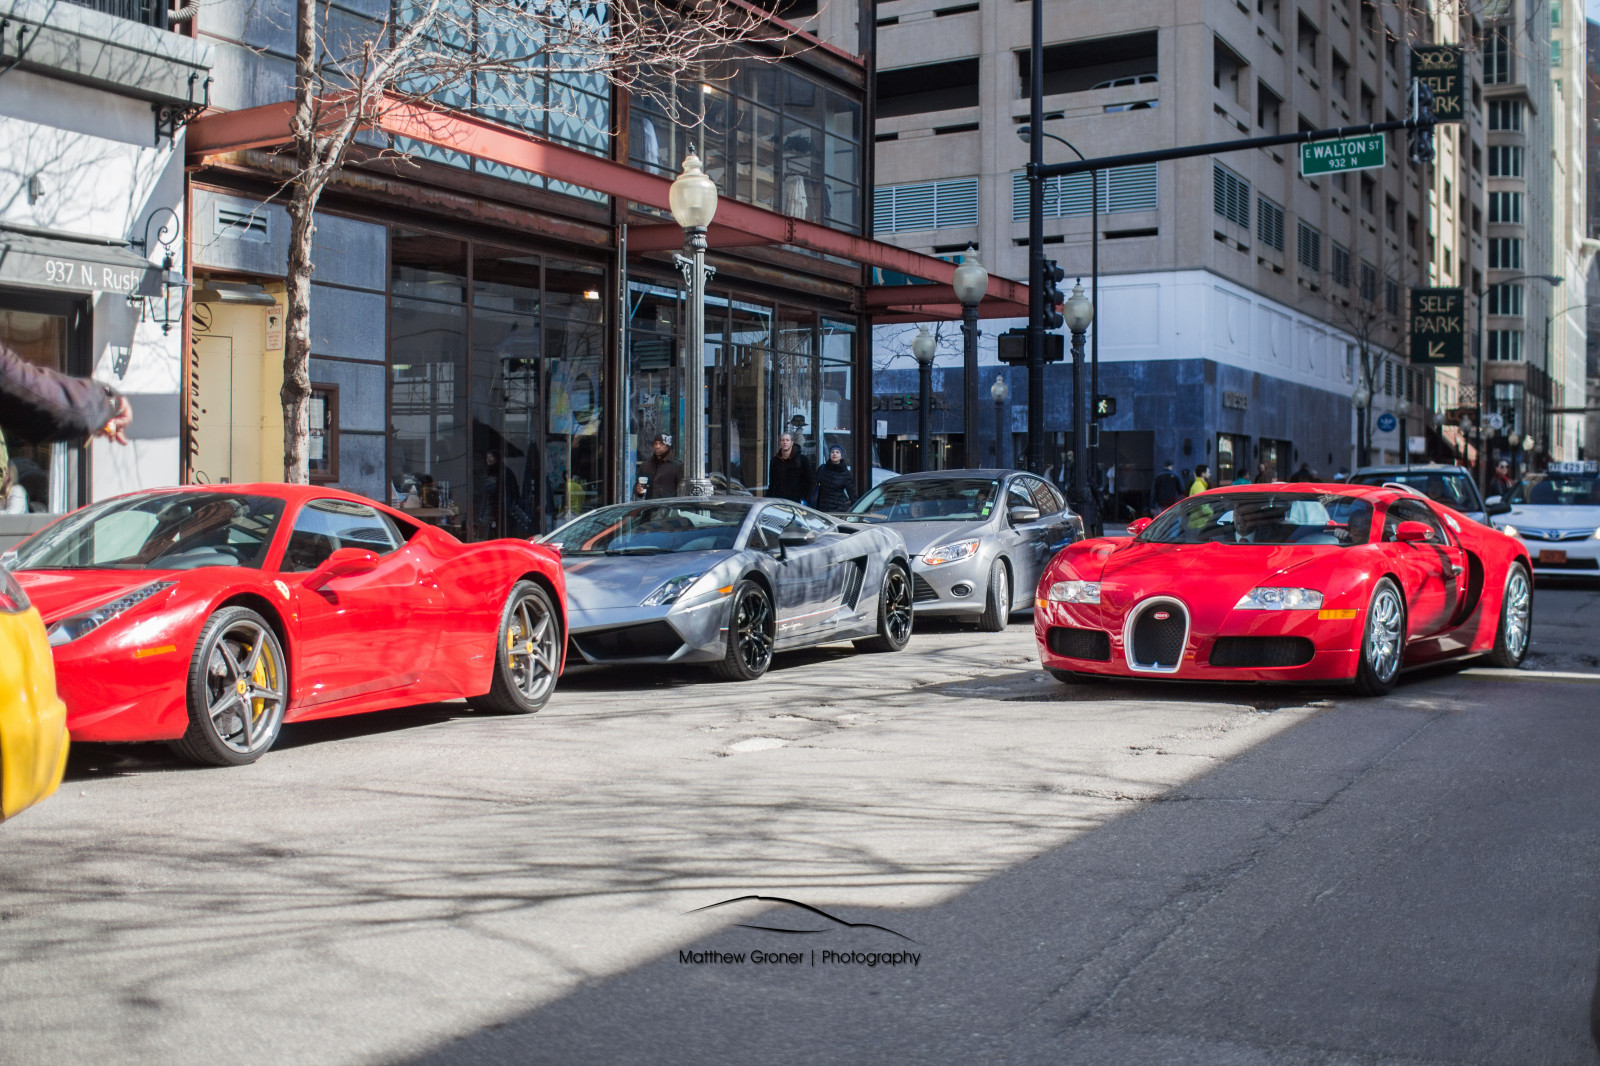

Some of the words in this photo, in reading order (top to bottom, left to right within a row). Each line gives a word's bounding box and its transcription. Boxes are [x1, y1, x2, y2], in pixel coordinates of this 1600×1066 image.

[1305, 149, 1312, 158] E
[1313, 140, 1366, 159] WALTON
[1368, 140, 1380, 151] ST
[1328, 158, 1346, 168] 932
[1350, 156, 1358, 166] N
[45, 259, 75, 284] 937
[81, 264, 98, 287] N.
[103, 267, 140, 291] Rush
[1420, 295, 1456, 313] SELF
[1415, 315, 1460, 334] PARK
[872, 394, 952, 411] IESL
